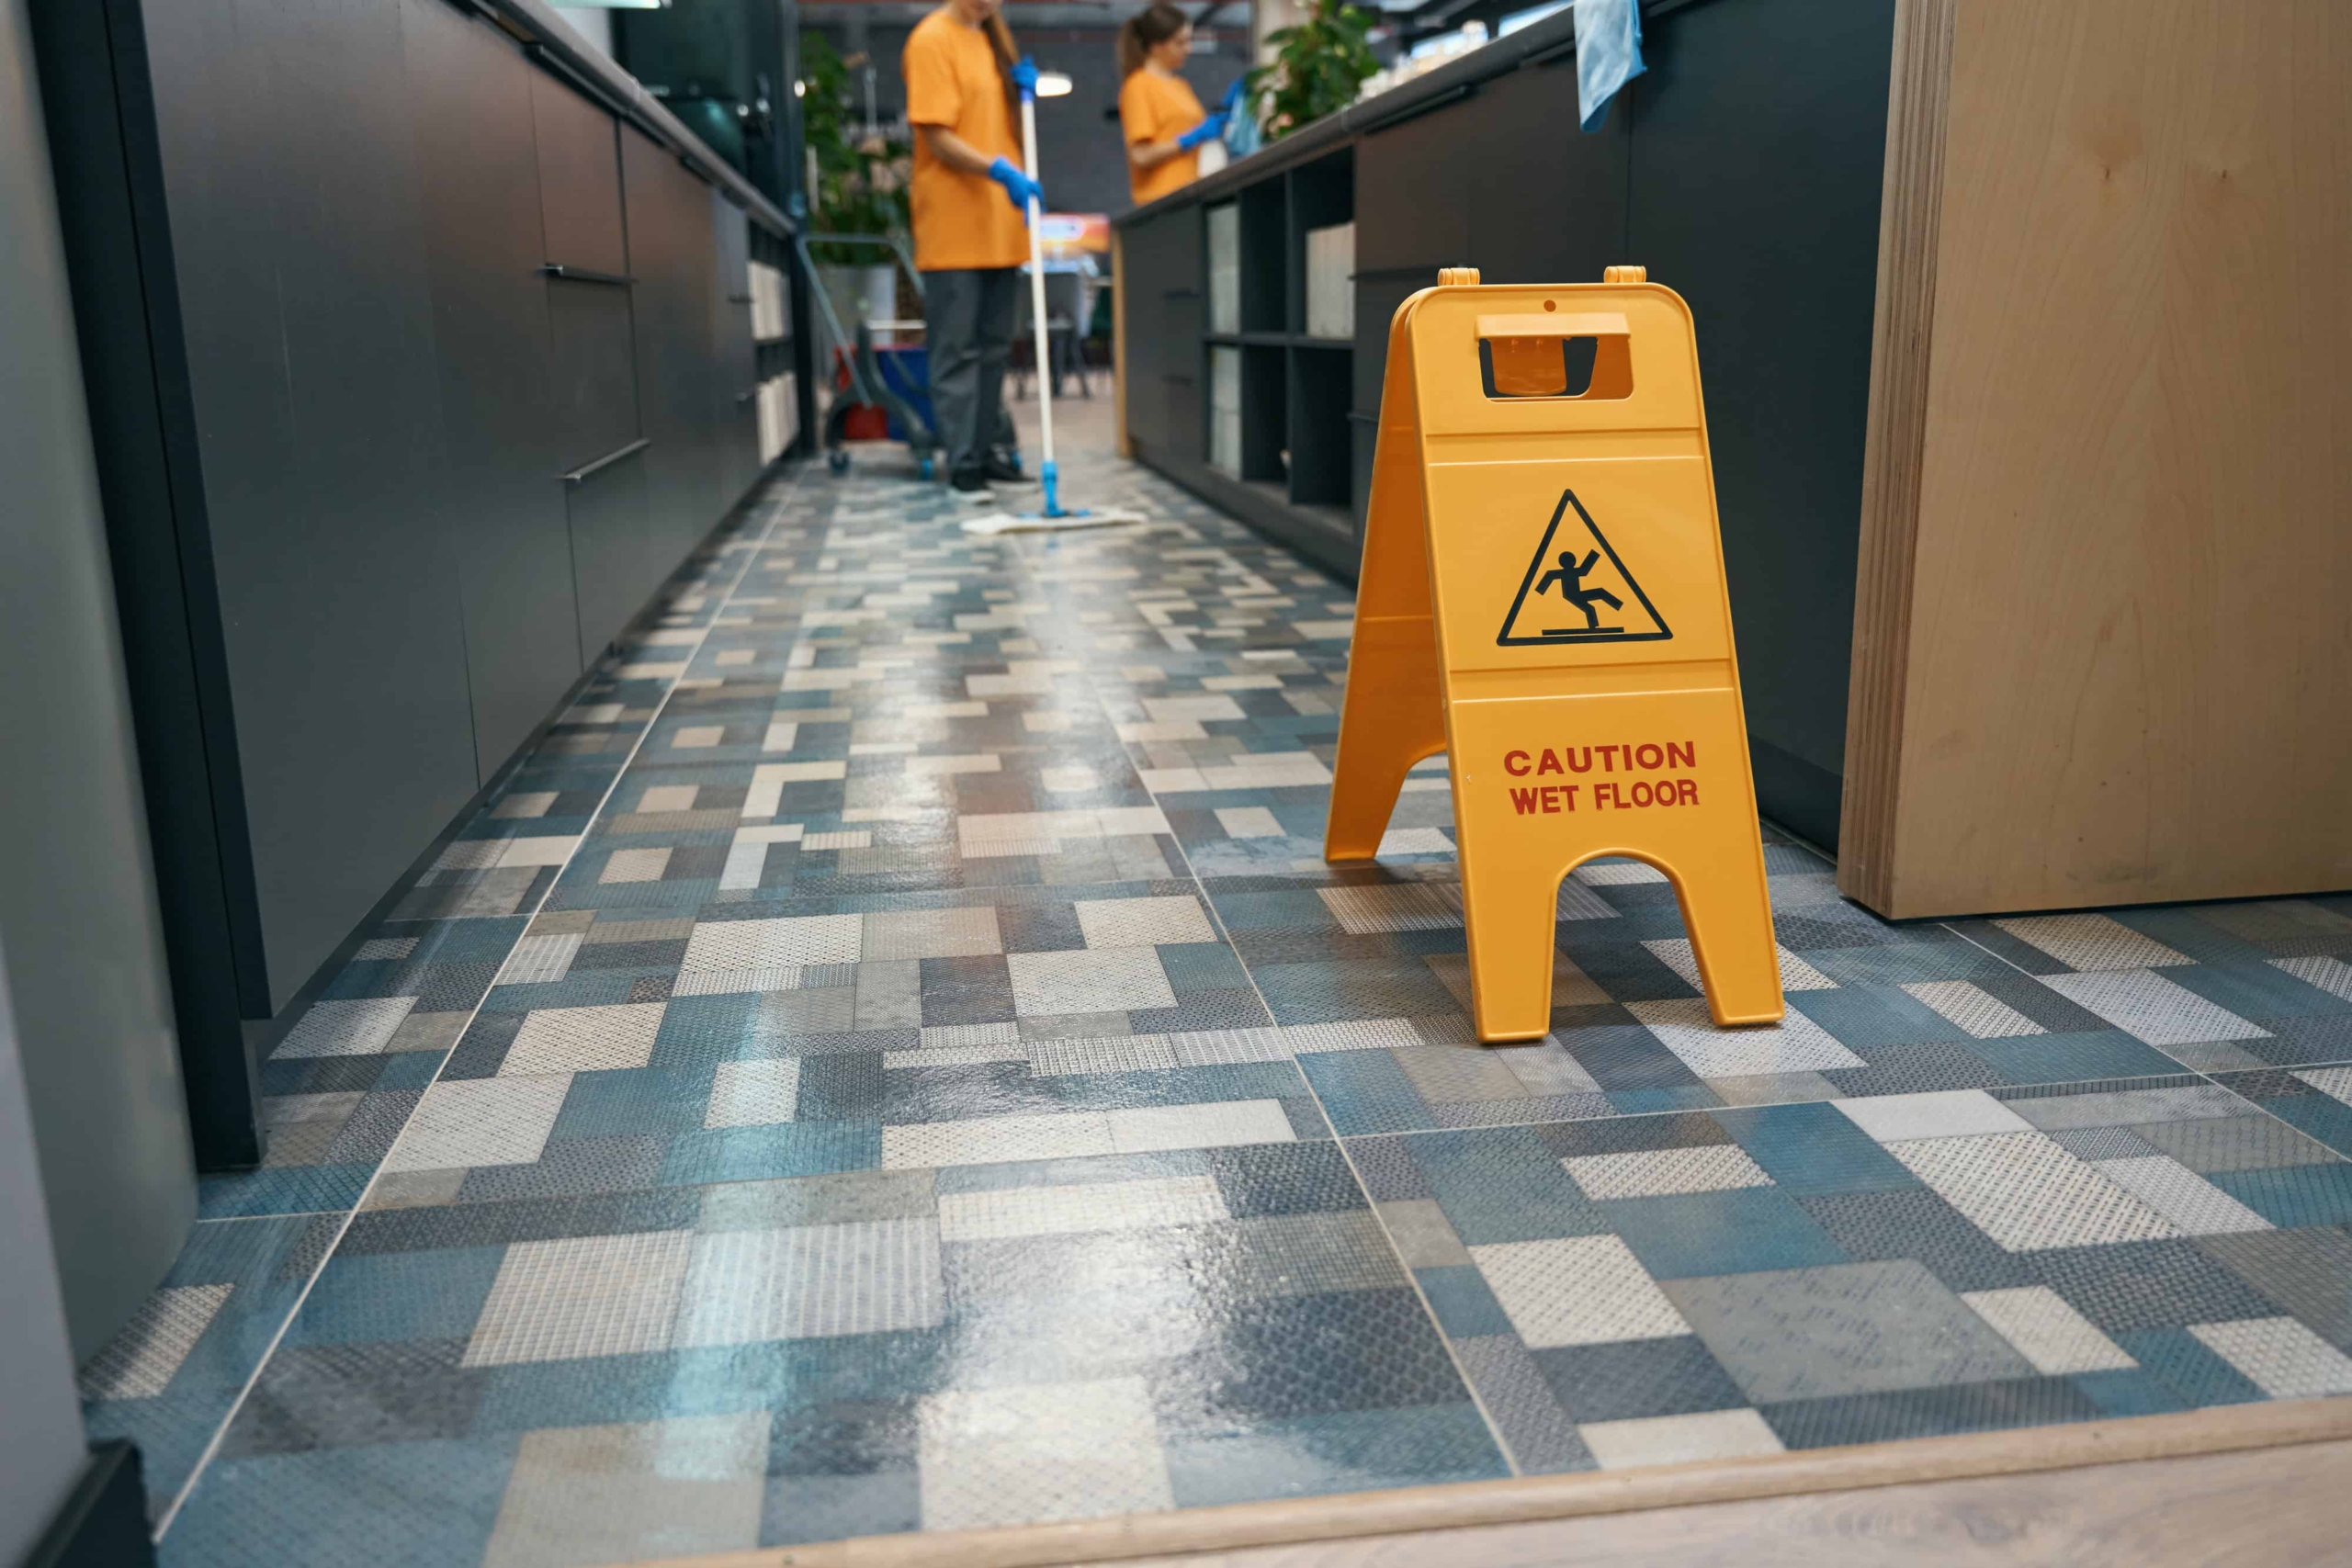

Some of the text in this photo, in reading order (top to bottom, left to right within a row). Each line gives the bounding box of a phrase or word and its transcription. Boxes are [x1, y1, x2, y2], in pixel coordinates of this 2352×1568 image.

[1504, 741, 1696, 777] CAUTION
[1510, 779, 1700, 815] WET FLOOR
